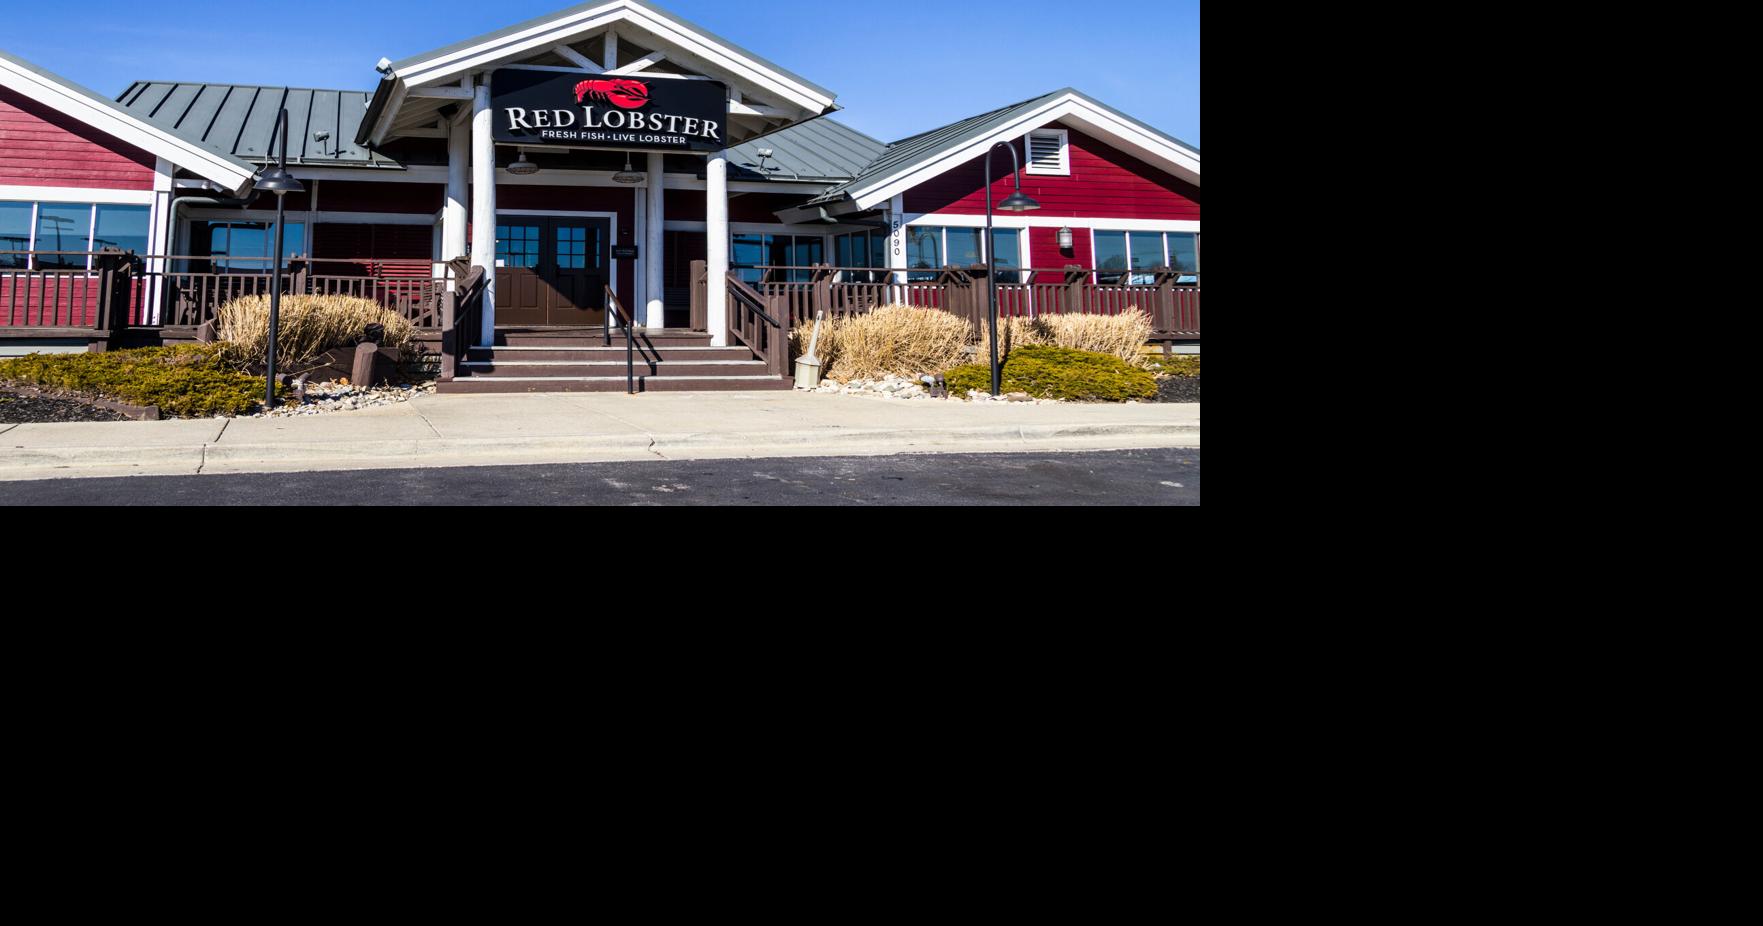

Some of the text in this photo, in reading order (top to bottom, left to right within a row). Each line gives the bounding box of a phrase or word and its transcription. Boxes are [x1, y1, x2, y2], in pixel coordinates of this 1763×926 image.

[504, 105, 720, 139] RED LOBSTER
[541, 129, 687, 144] FRESH FISH LIVE LOBSTER
